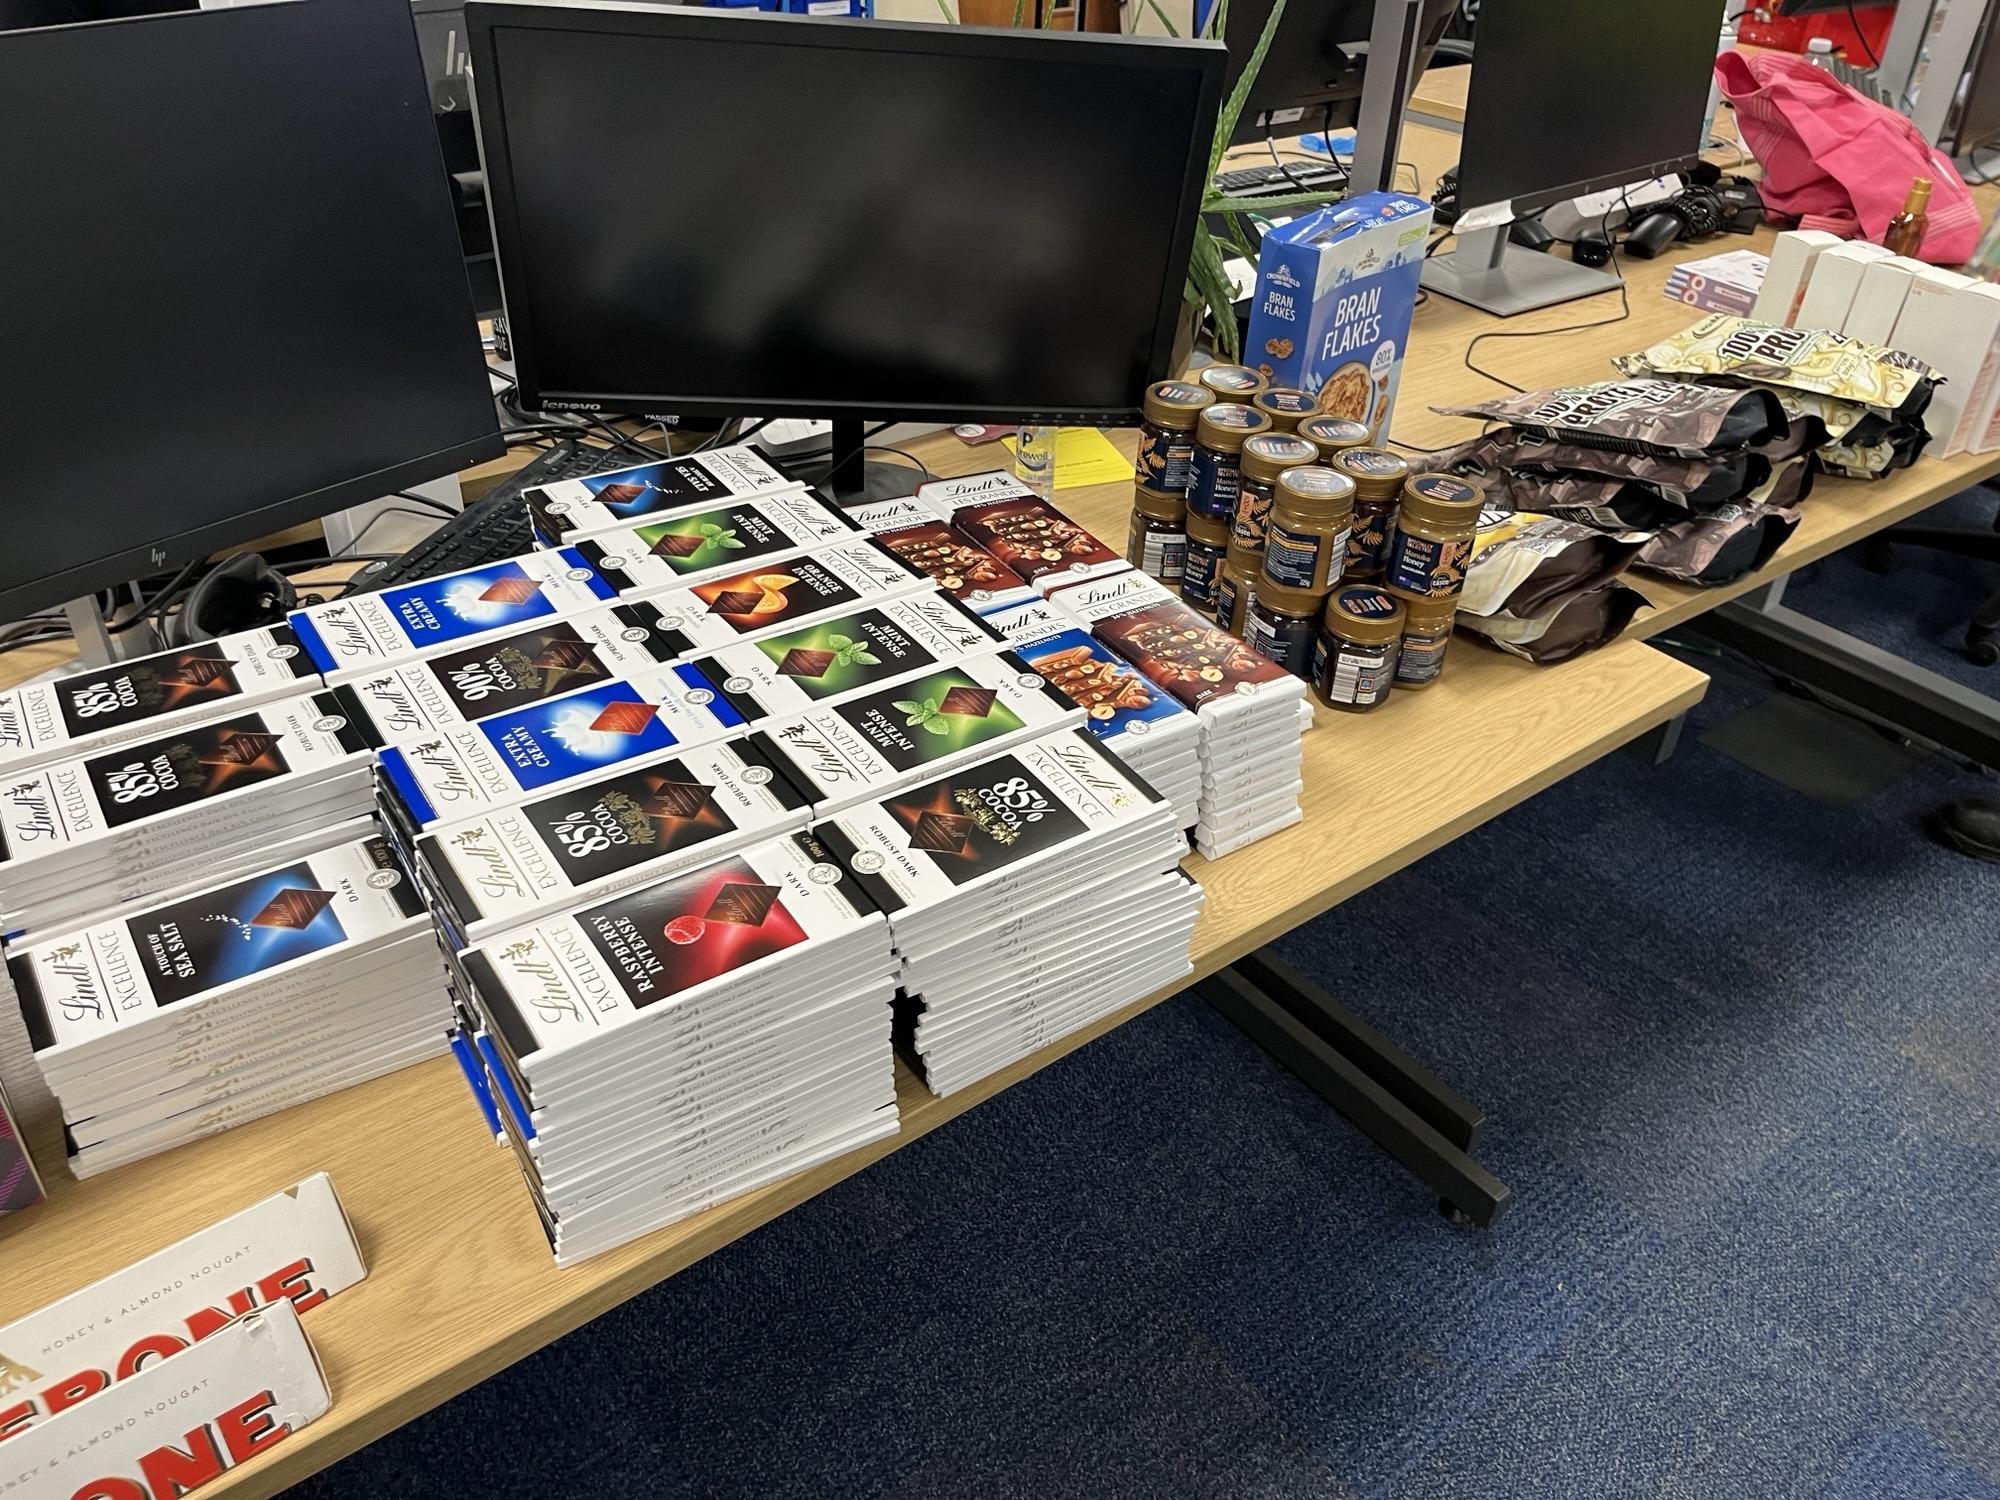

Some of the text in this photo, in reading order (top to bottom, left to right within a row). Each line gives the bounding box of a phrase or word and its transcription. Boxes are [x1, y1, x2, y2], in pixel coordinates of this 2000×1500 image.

[1266, 273, 1301, 288] CROWNFIELD
[1269, 291, 1294, 309] BRAN
[1264, 302, 1296, 322] FLAKES
[1334, 287, 1382, 328] BRAN
[1322, 314, 1382, 361] FLAKES
[542, 400, 602, 411] lenovo
[675, 465, 710, 492] SEA SALT
[703, 455, 750, 490] EXCELLENCE
[946, 480, 995, 497] Lindt
[851, 505, 900, 523] Lindt
[976, 488, 1024, 504] GRANDES
[733, 514, 770, 544] INTENSE
[749, 515, 777, 536] MINT
[760, 502, 812, 542] EXCELLENCE
[875, 513, 931, 530] GRANDES
[803, 563, 845, 594] ORANGE
[818, 552, 876, 592] EXCELLENCE
[841, 547, 895, 576] Lindt
[791, 567, 832, 597] INTENSE
[1077, 582, 1129, 606] Lindt
[399, 602, 425, 631] EXTRA
[409, 597, 441, 631] CREAMY
[686, 605, 708, 623] DARK
[912, 600, 972, 635] Lindt
[1088, 590, 1166, 618] LES GRANDES
[1127, 602, 1161, 615] HAZELNUTS
[326, 619, 375, 656] Lindt
[358, 600, 403, 652] EXCELLENCE
[861, 621, 908, 659] INTENSE
[878, 623, 912, 649] MINT
[889, 605, 954, 656] EXCELLENCE
[1025, 634, 1062, 649] HAZELNUTS
[114, 675, 139, 708] COCOA
[448, 663, 504, 702] 90%
[485, 656, 518, 691] COCOA
[750, 666, 776, 688] DARK
[999, 678, 1023, 700] DARK
[71, 682, 121, 718] 85%
[373, 690, 426, 732] Lindt
[405, 668, 454, 725] EXCELLENCE
[1195, 689, 1214, 700] DARK
[28, 689, 57, 742] EXCELLENCE
[860, 721, 895, 748] MINT
[865, 708, 916, 751] INTENSE
[455, 730, 509, 795] EXCELLENCE
[500, 733, 532, 768] EXTRA
[511, 726, 551, 768] CREAMY
[791, 739, 858, 783] Lindt
[816, 714, 884, 776] EXCELLENCE
[105, 762, 160, 804] 85%
[151, 754, 180, 791] COCOA
[420, 755, 479, 801] Lindt
[709, 762, 753, 808] ROBUST DARK
[1026, 752, 1105, 821] EXCELLENCE
[1049, 745, 1122, 792] Lindt
[12, 796, 58, 842] Lindt
[56, 769, 94, 833] EXCELLENCE
[978, 788, 1024, 832] COCOA
[993, 777, 1057, 823] 85%
[549, 811, 611, 858] 85%
[590, 803, 629, 845] COCOA
[498, 816, 558, 890] EXCELLENCE
[869, 825, 920, 878] ROBUST DARK
[339, 878, 360, 903] DARK
[462, 845, 526, 898] Lindt
[784, 871, 810, 897] DARK
[147, 933, 174, 977] A TOUCH OF
[160, 921, 197, 979] SEA SALT
[590, 915, 657, 993] RASPBERRY
[614, 916, 666, 975] INTENSE
[98, 930, 143, 1011] EXCELLENCE
[550, 924, 620, 1013] EXCELLENCE
[52, 962, 105, 1022] Lindt
[512, 960, 585, 1024] Lindt
[42, 1246, 252, 1355] HONEY & ALMOND NOUGAT
[67, 1417, 138, 1458] ALMOND
[144, 1379, 209, 1417] NOUGAT
